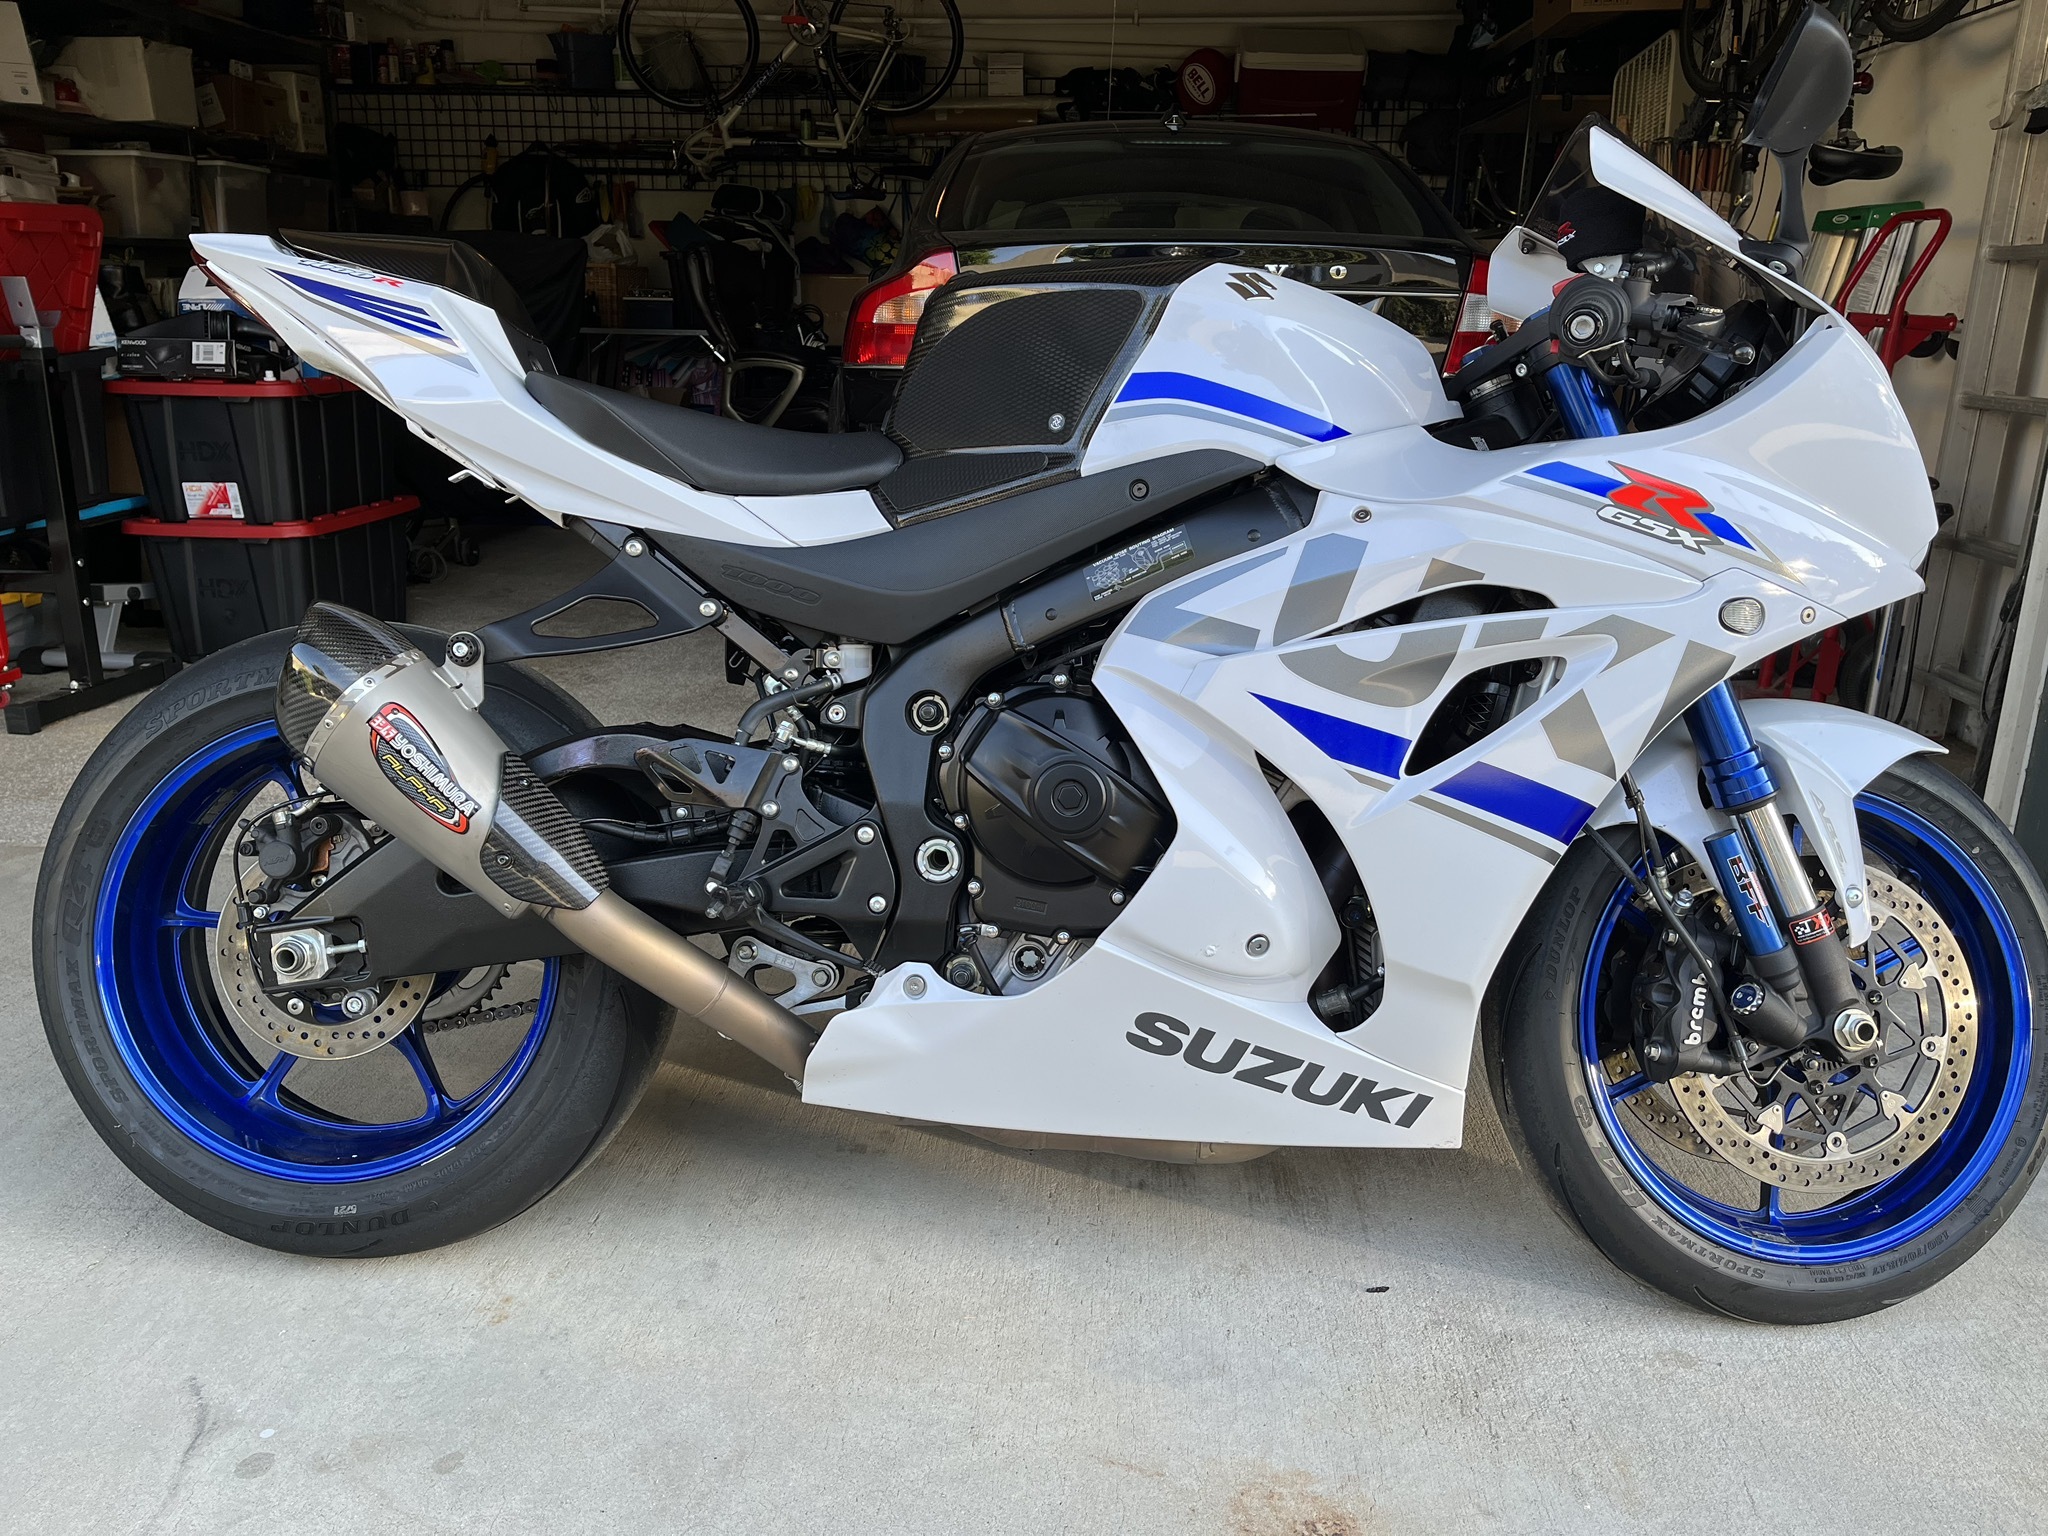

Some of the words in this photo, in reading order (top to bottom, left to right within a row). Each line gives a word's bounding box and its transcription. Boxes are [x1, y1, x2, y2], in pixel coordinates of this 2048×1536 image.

[1188, 68, 1210, 100] BELL
[178, 440, 233, 463] HDX
[1597, 504, 1718, 554] GSX
[720, 563, 823, 607] 1000
[145, 666, 281, 740] SPORTM
[382, 754, 448, 813] ALPHA
[389, 732, 475, 817] YOSHIMURA
[1545, 886, 1581, 984] DUNLOP
[65, 957, 130, 1104] SPORTMAX
[1683, 959, 1713, 1045] bremb
[1126, 1011, 1434, 1129] SUZUKI
[270, 1207, 410, 1236] DUNLOP
[1651, 1215, 1766, 1280] SPORTMAX
